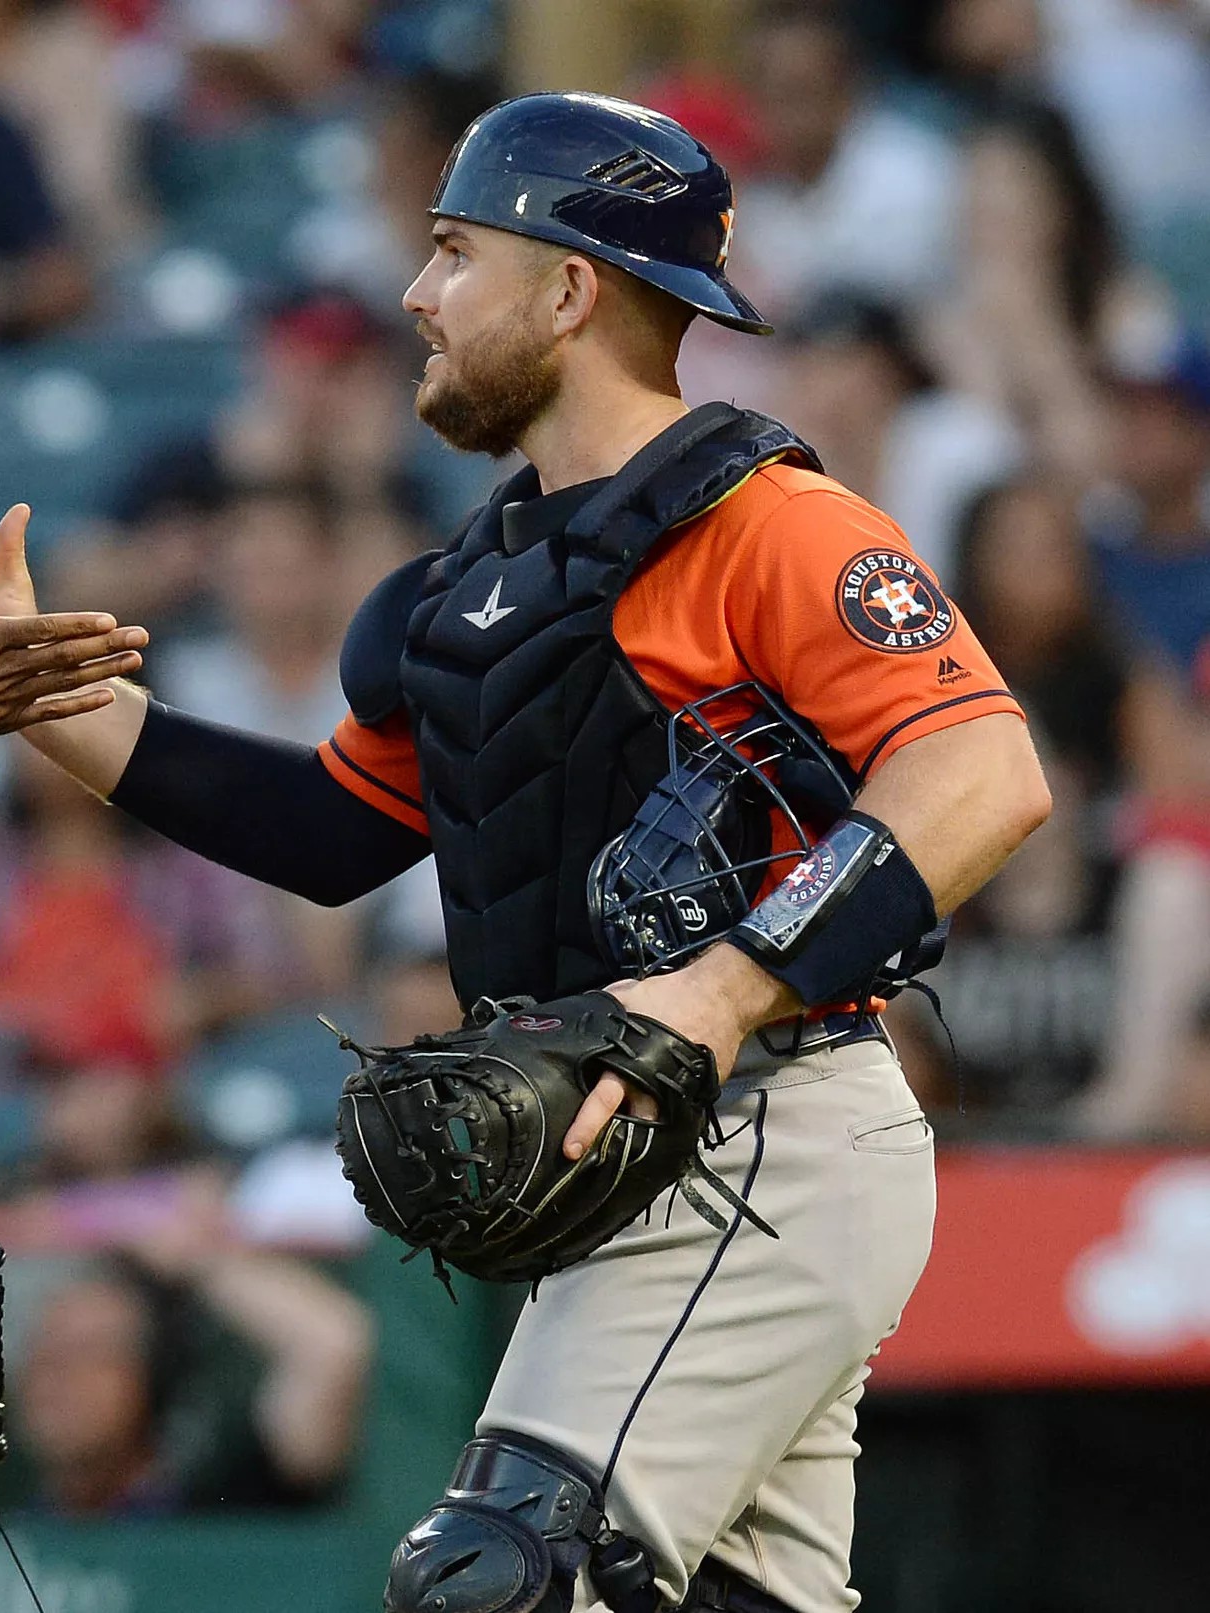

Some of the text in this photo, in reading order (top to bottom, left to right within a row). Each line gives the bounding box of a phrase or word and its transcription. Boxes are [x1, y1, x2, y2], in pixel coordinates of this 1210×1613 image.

[844, 555, 917, 599] HOUSTON
[871, 579, 926, 624] H
[884, 611, 950, 645] ASTROS
[791, 856, 832, 902] HOUSTON
